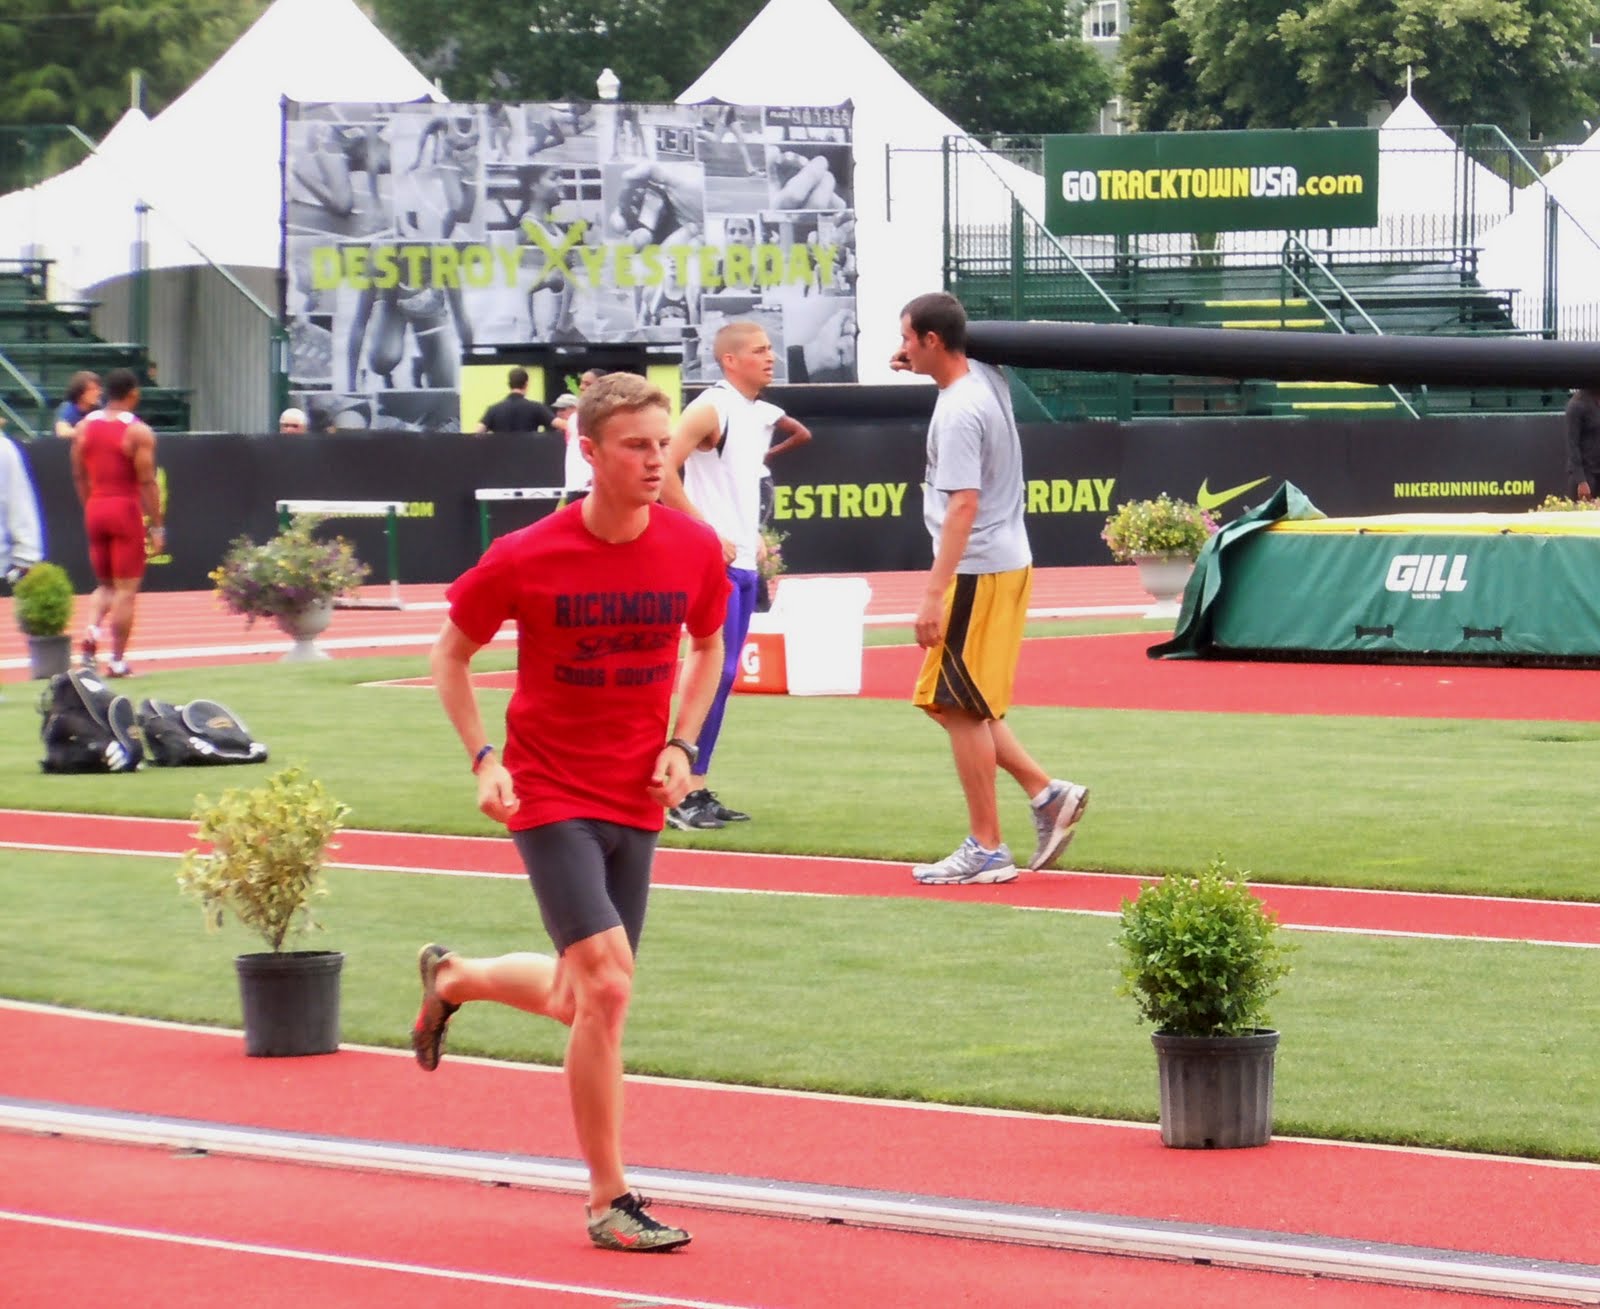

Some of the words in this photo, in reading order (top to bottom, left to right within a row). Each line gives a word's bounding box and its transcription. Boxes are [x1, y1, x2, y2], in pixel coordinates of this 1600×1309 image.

[1062, 166, 1363, 202] GOTRACKTOWNUSA.com
[311, 245, 525, 290] DESTROY
[580, 243, 838, 288] YESTERDAY
[773, 482, 908, 520] ESTROY
[1023, 478, 1116, 514] RDAY
[1394, 480, 1535, 498] NIKERUNNING.COM
[1385, 554, 1469, 592] GILL
[555, 591, 688, 628] RICHMOND
